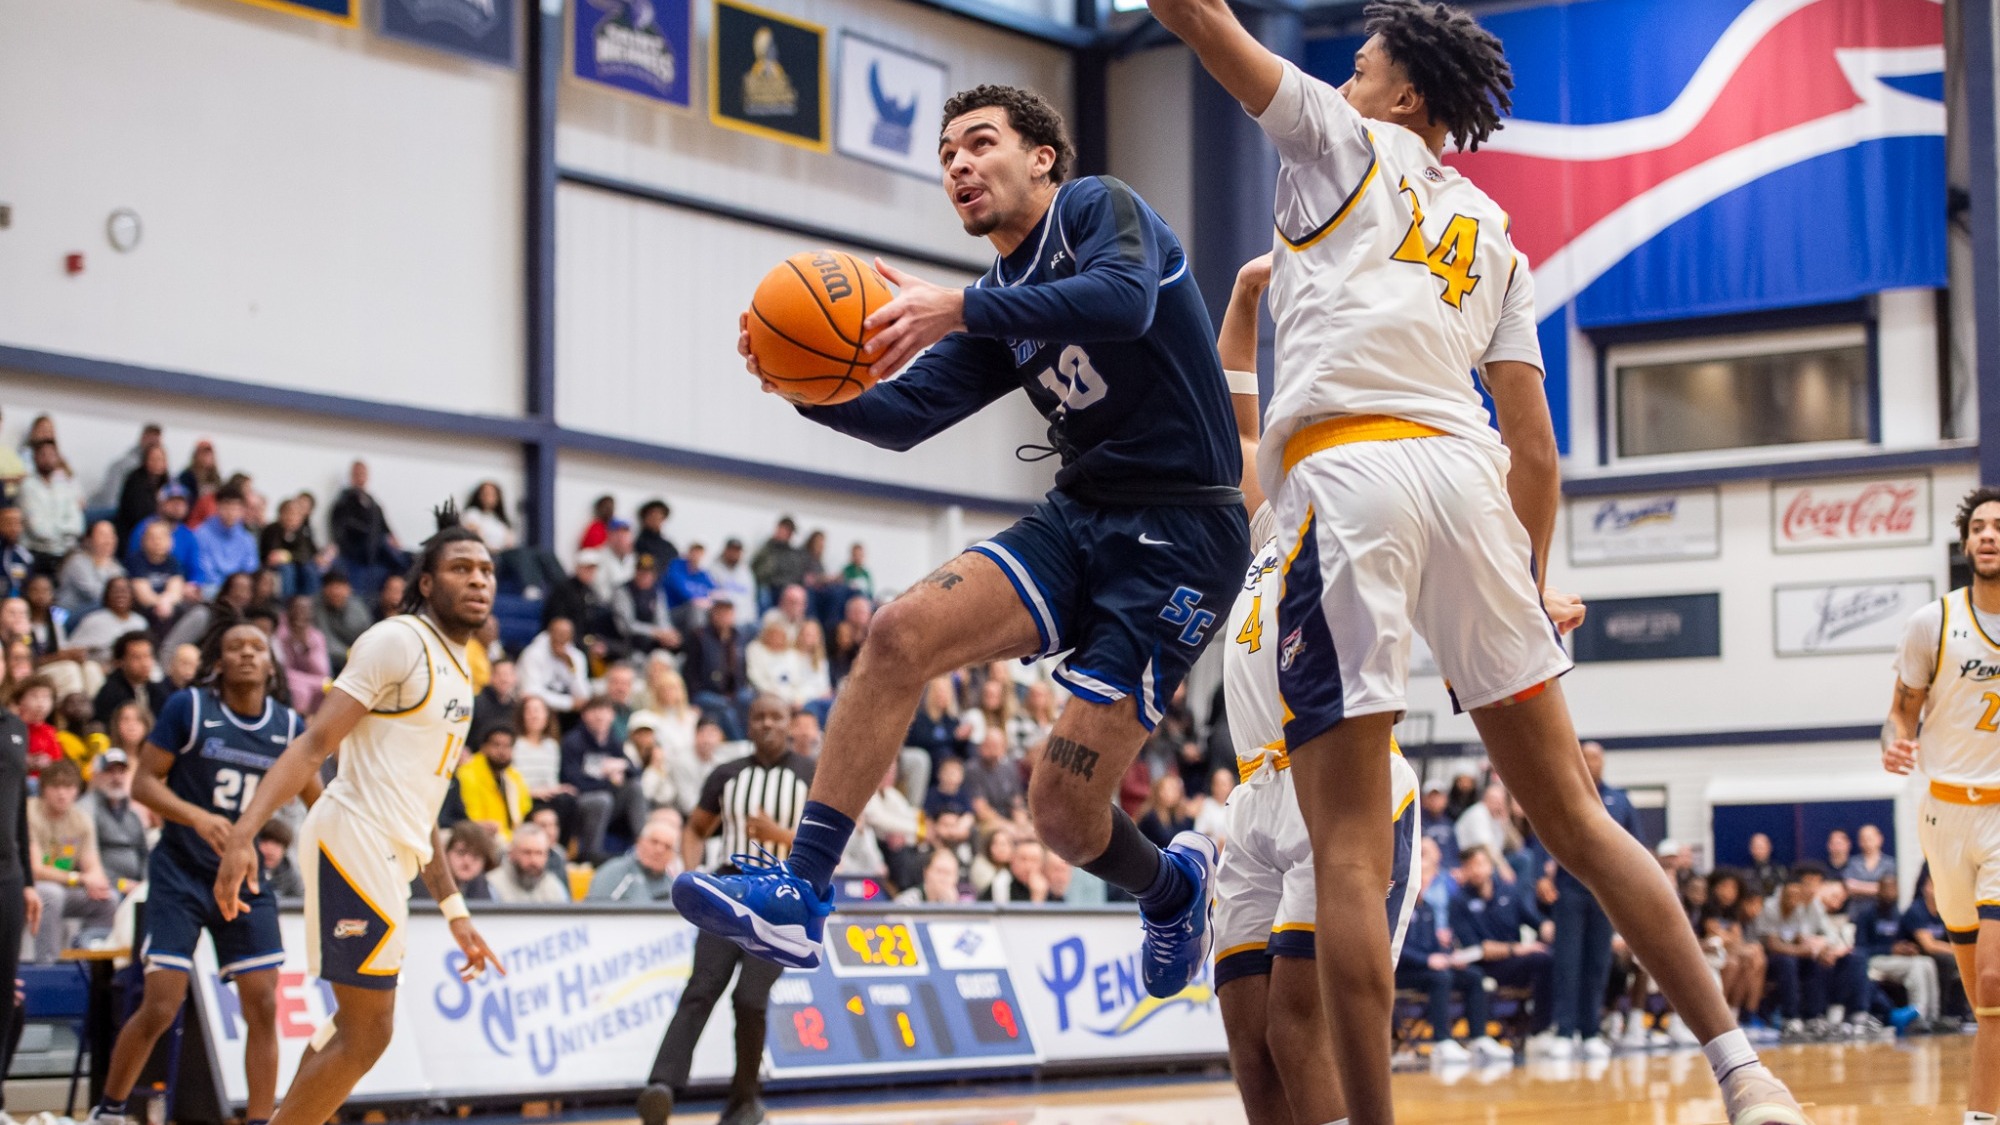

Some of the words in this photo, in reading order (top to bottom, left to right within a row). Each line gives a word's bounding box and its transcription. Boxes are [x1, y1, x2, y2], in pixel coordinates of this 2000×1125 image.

[1037, 344, 1109, 411] 10
[1158, 584, 1217, 647] SC
[1235, 592, 1264, 655] 4
[213, 768, 259, 814] 21
[845, 924, 918, 967] 9:23
[481, 983, 549, 1057] NEW
[793, 1006, 829, 1051] 12
[896, 1011, 916, 1048] 1
[991, 999, 1019, 1038] 9
